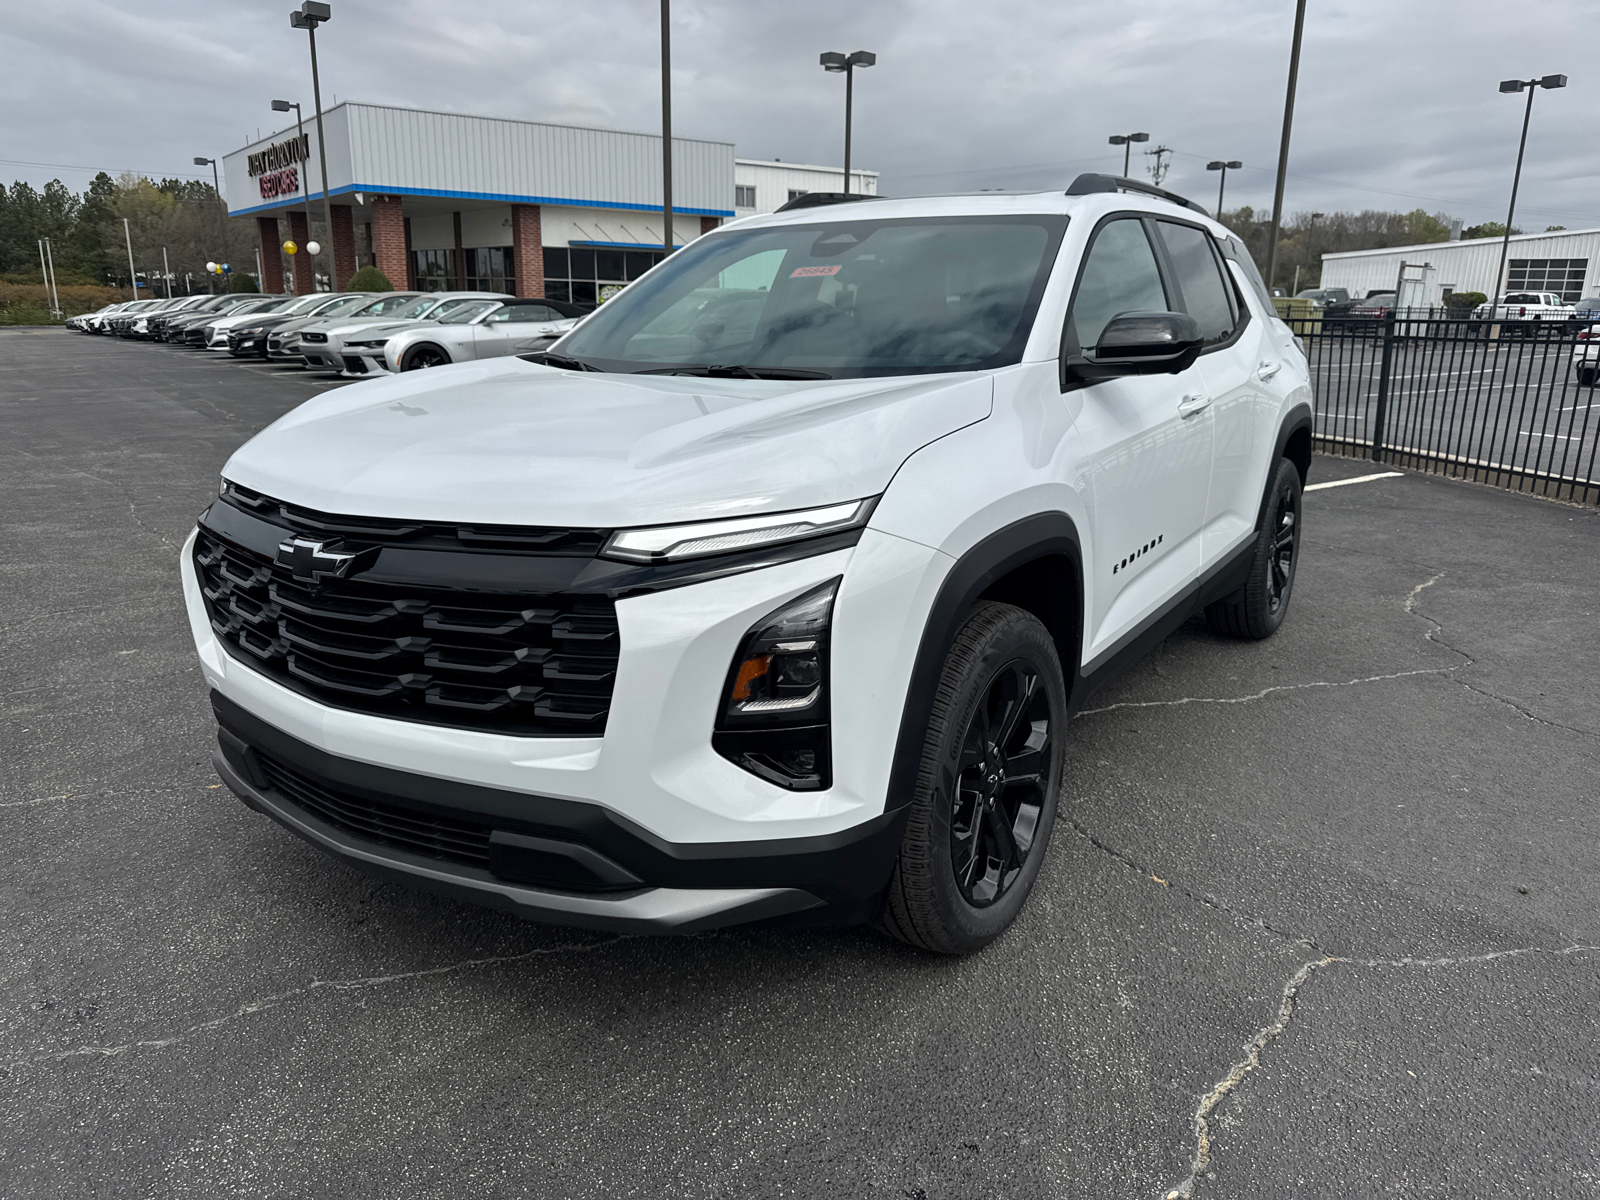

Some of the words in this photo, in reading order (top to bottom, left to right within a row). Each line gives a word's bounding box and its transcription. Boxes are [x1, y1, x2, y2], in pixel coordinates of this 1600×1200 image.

[247, 151, 266, 177] JOHN
[259, 174, 278, 198] USED
[276, 168, 298, 194] CARS
[949, 679, 980, 761] Continental
